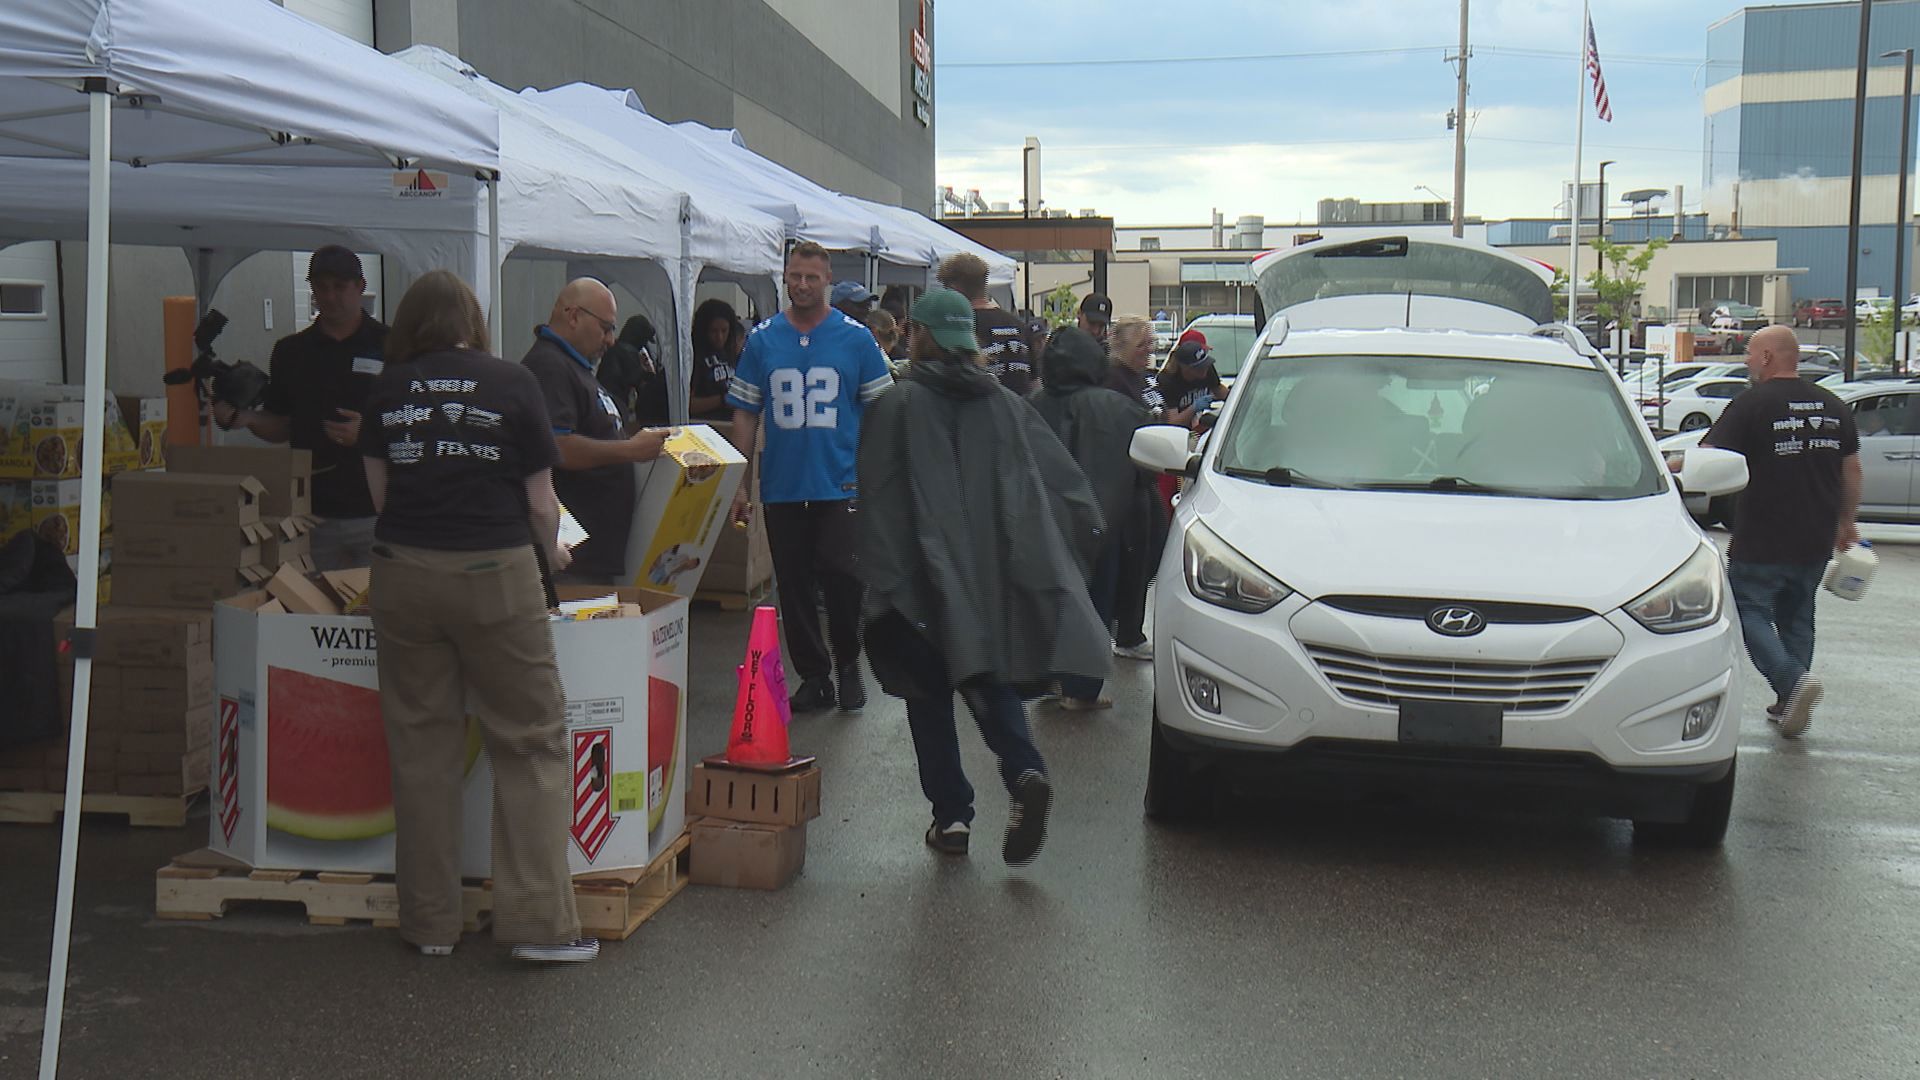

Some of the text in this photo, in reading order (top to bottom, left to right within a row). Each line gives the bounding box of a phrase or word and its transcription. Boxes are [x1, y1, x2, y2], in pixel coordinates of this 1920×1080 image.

[381, 403, 433, 427] meijer
[769, 367, 840, 429] 82
[751, 650, 762, 680] WET
[743, 683, 757, 732] FLOOR
